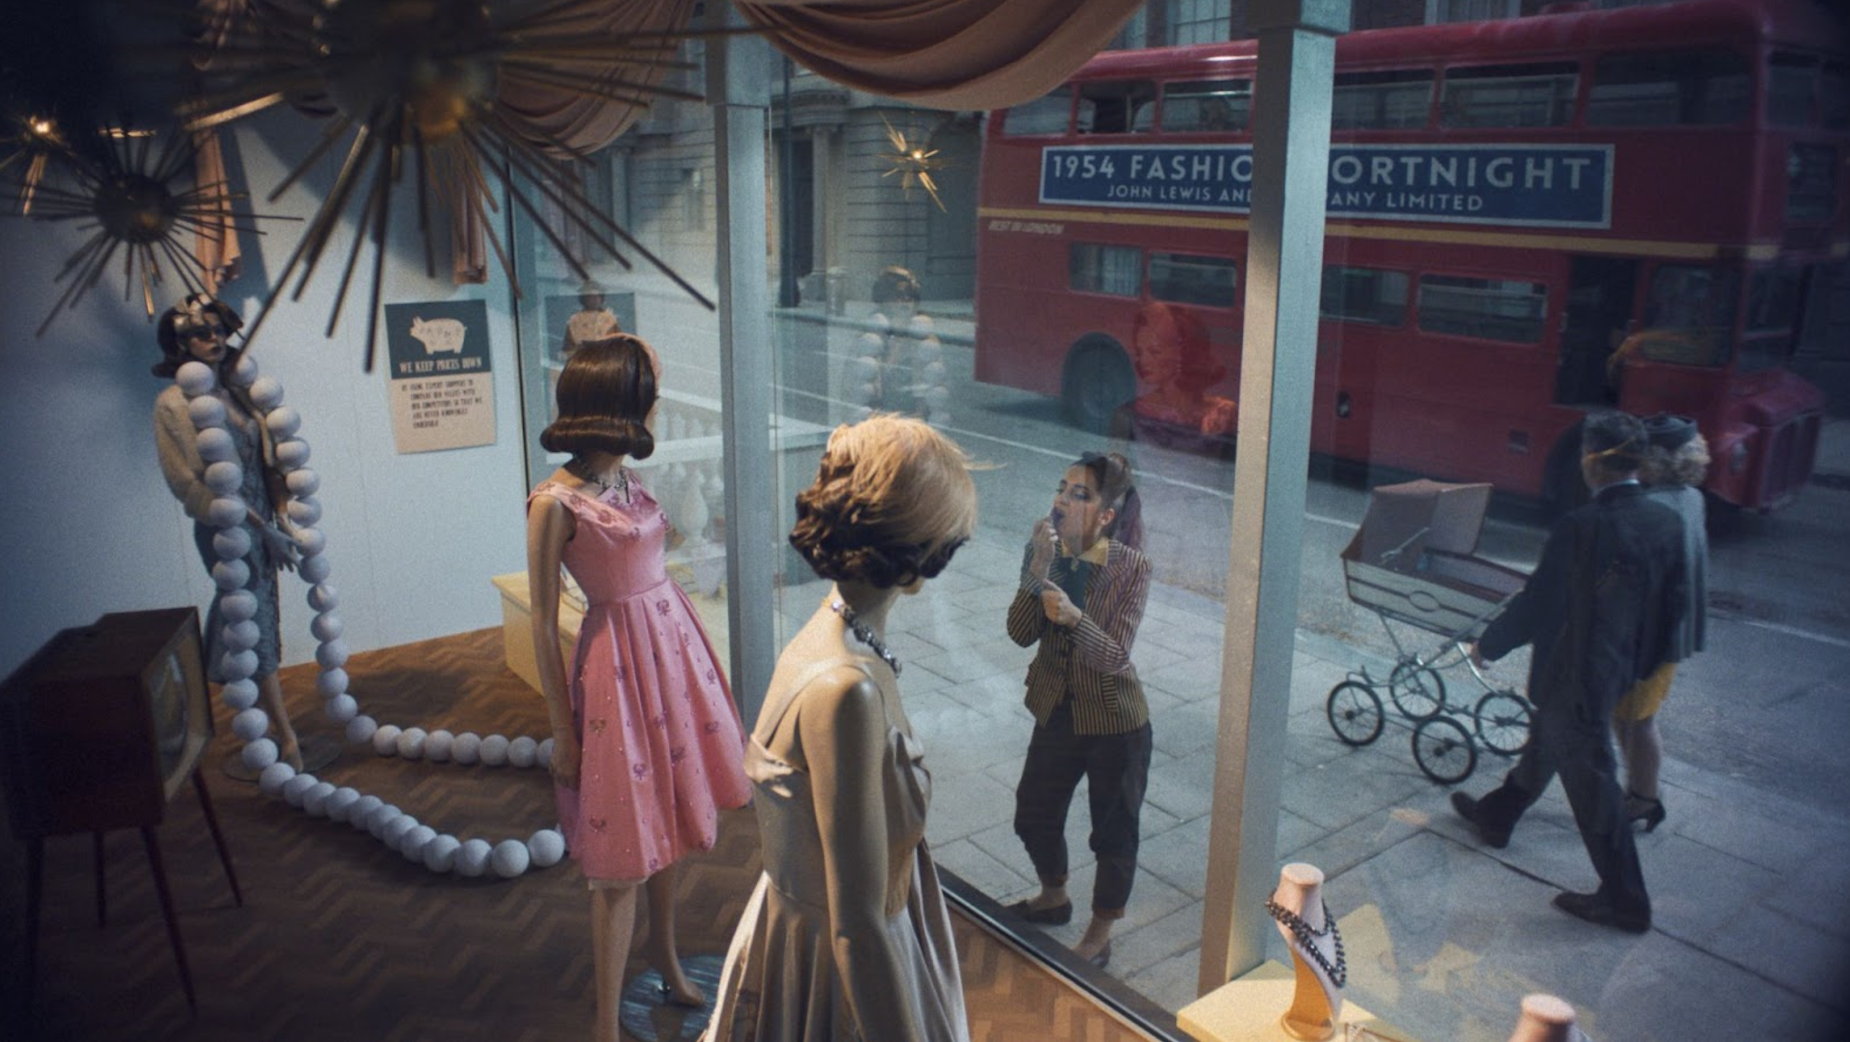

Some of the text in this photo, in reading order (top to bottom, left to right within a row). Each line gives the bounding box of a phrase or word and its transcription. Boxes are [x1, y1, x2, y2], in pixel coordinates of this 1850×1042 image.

[1053, 155, 1591, 189] 1954 FASHIO ORTNIGHT
[1107, 184, 1152, 198] JOHN
[1160, 187, 1211, 201] LEWIS
[1387, 193, 1483, 211] LIMITED
[1022, 222, 1064, 234] LONDON
[399, 357, 482, 373] WE KEEP PRICES DOWN
